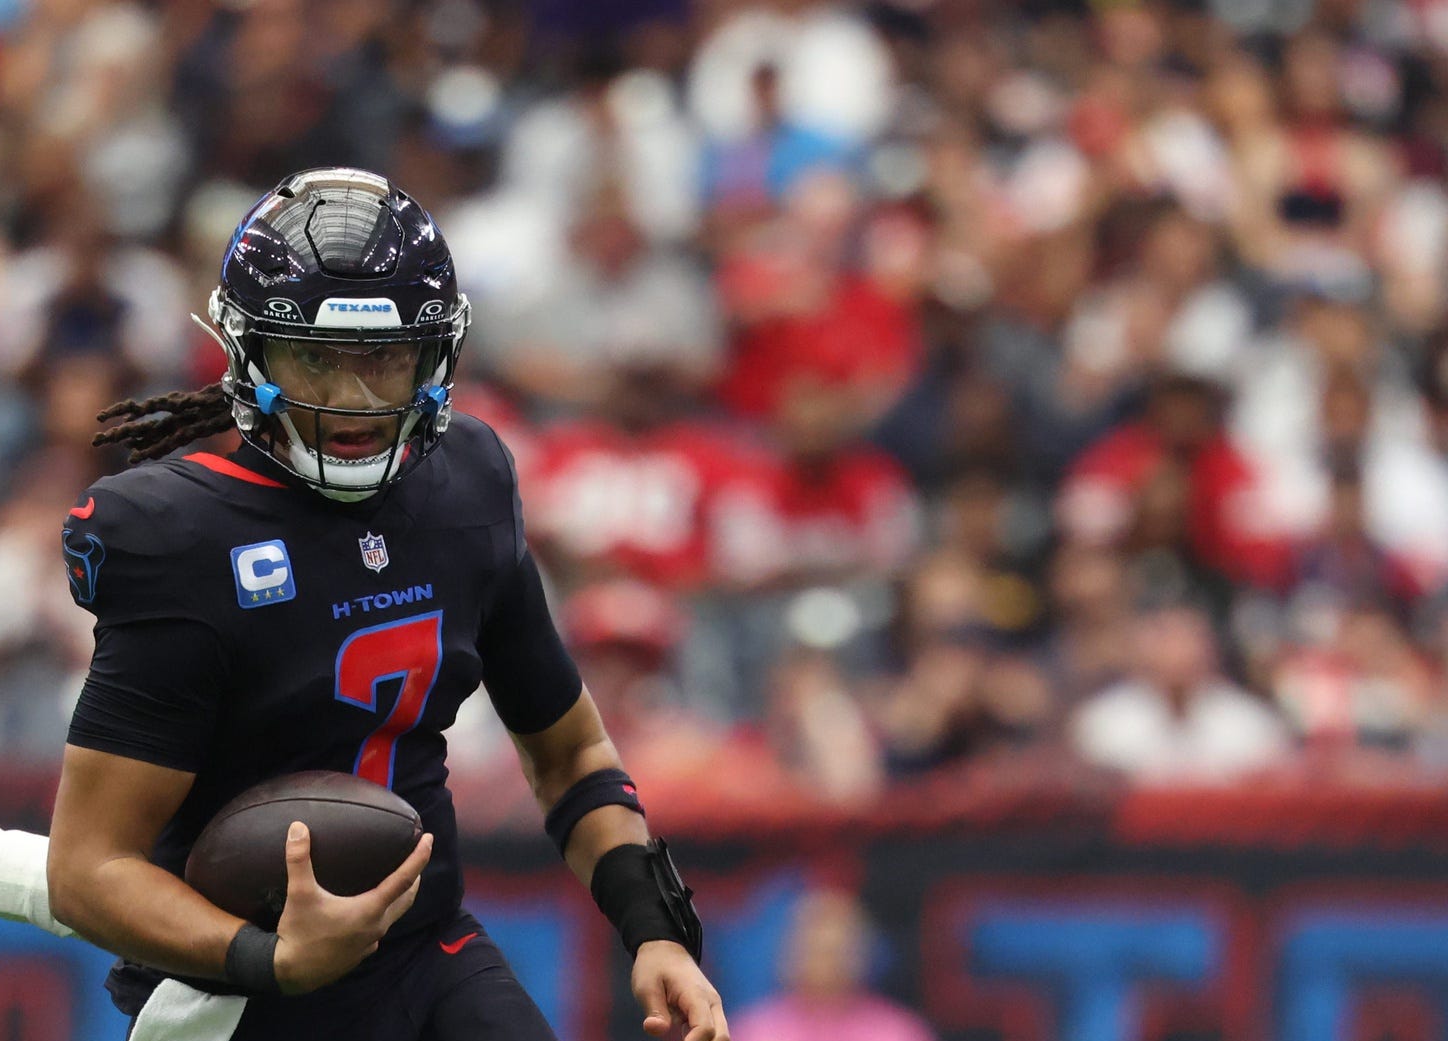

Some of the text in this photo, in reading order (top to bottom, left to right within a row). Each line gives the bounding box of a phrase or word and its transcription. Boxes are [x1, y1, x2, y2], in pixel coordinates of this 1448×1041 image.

[263, 310, 299, 320] OAKLEY
[327, 303, 393, 313] TEXANS
[420, 313, 446, 322] OAKLEY
[236, 544, 289, 592] C
[332, 583, 434, 620] H-TOWN
[334, 609, 444, 792] 7
